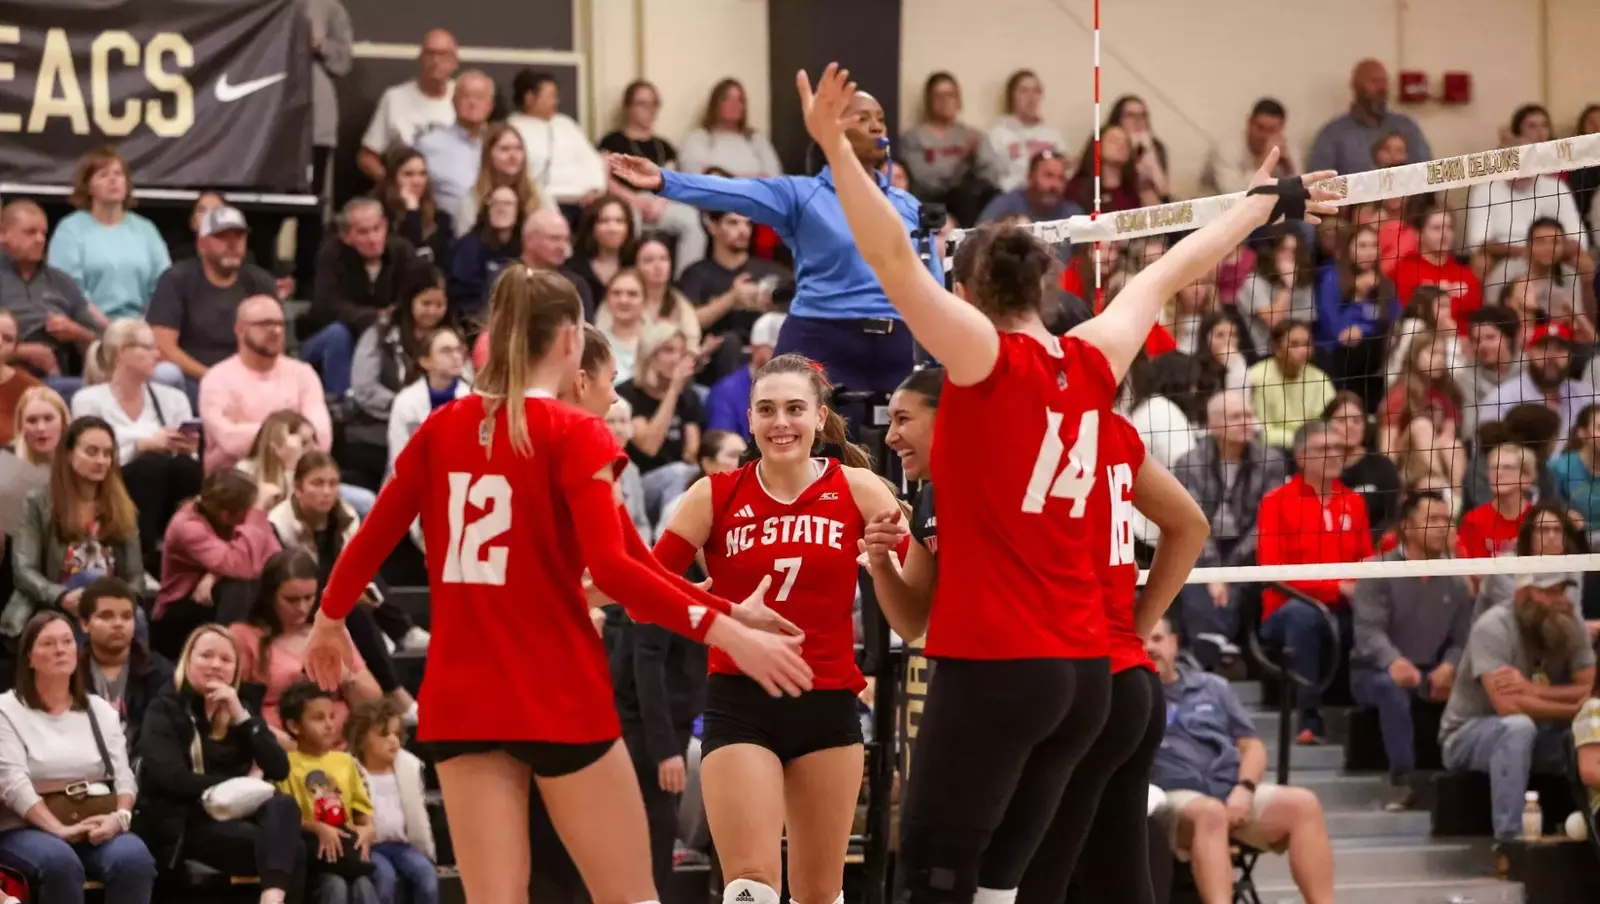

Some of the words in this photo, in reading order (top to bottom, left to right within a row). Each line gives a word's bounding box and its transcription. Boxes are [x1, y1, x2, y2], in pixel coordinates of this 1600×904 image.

[1427, 157, 1465, 184] DEMON
[1468, 148, 1520, 177] DEACONS
[1021, 405, 1099, 518] 14
[820, 492, 839, 501] ACC
[1106, 462, 1135, 566] 16
[442, 471, 513, 586] 12
[726, 523, 757, 558] NC
[760, 515, 845, 550] STATE
[774, 556, 803, 602] 7
